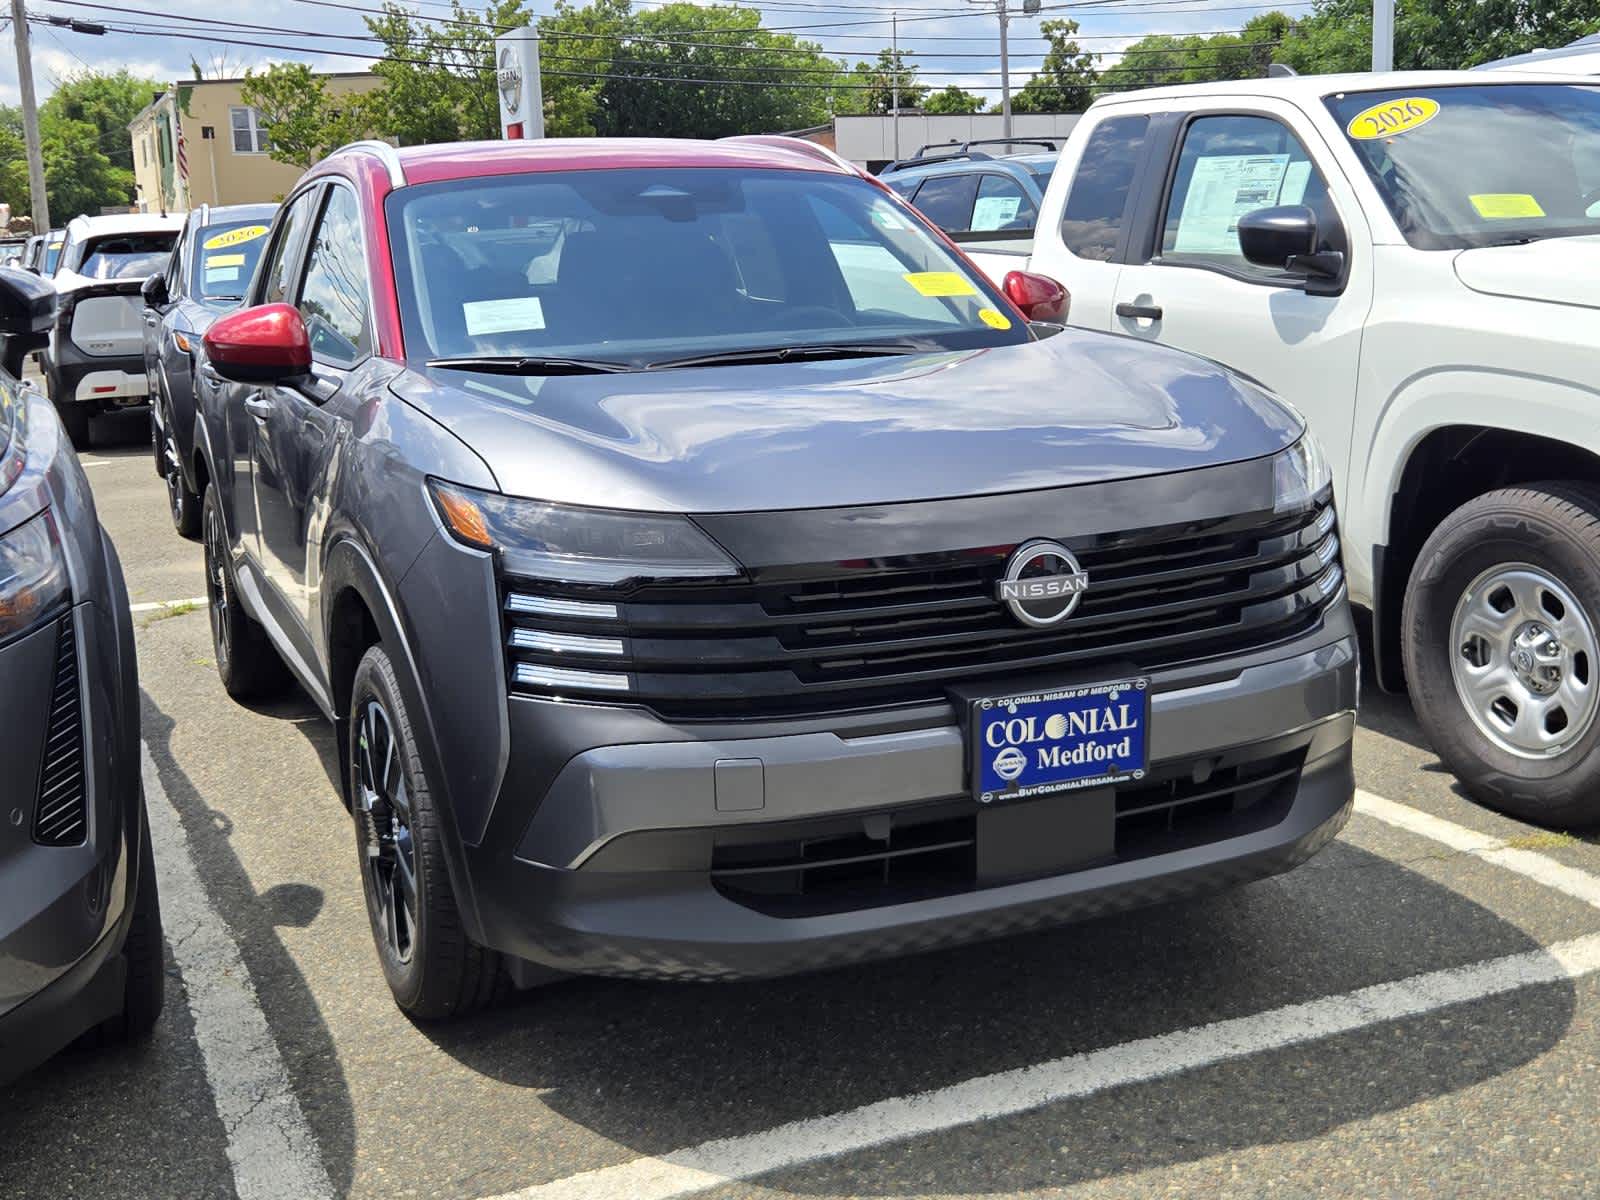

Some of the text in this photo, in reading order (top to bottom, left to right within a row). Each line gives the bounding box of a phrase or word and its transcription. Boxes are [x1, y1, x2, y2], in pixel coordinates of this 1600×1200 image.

[1363, 101, 1424, 134] 2026
[1003, 576, 1088, 597] NISSAN
[997, 683, 1131, 707] COLONIAL NISSAN OF MEDFORD
[985, 704, 1138, 748] COLONIAL
[1037, 736, 1131, 769] Medford
